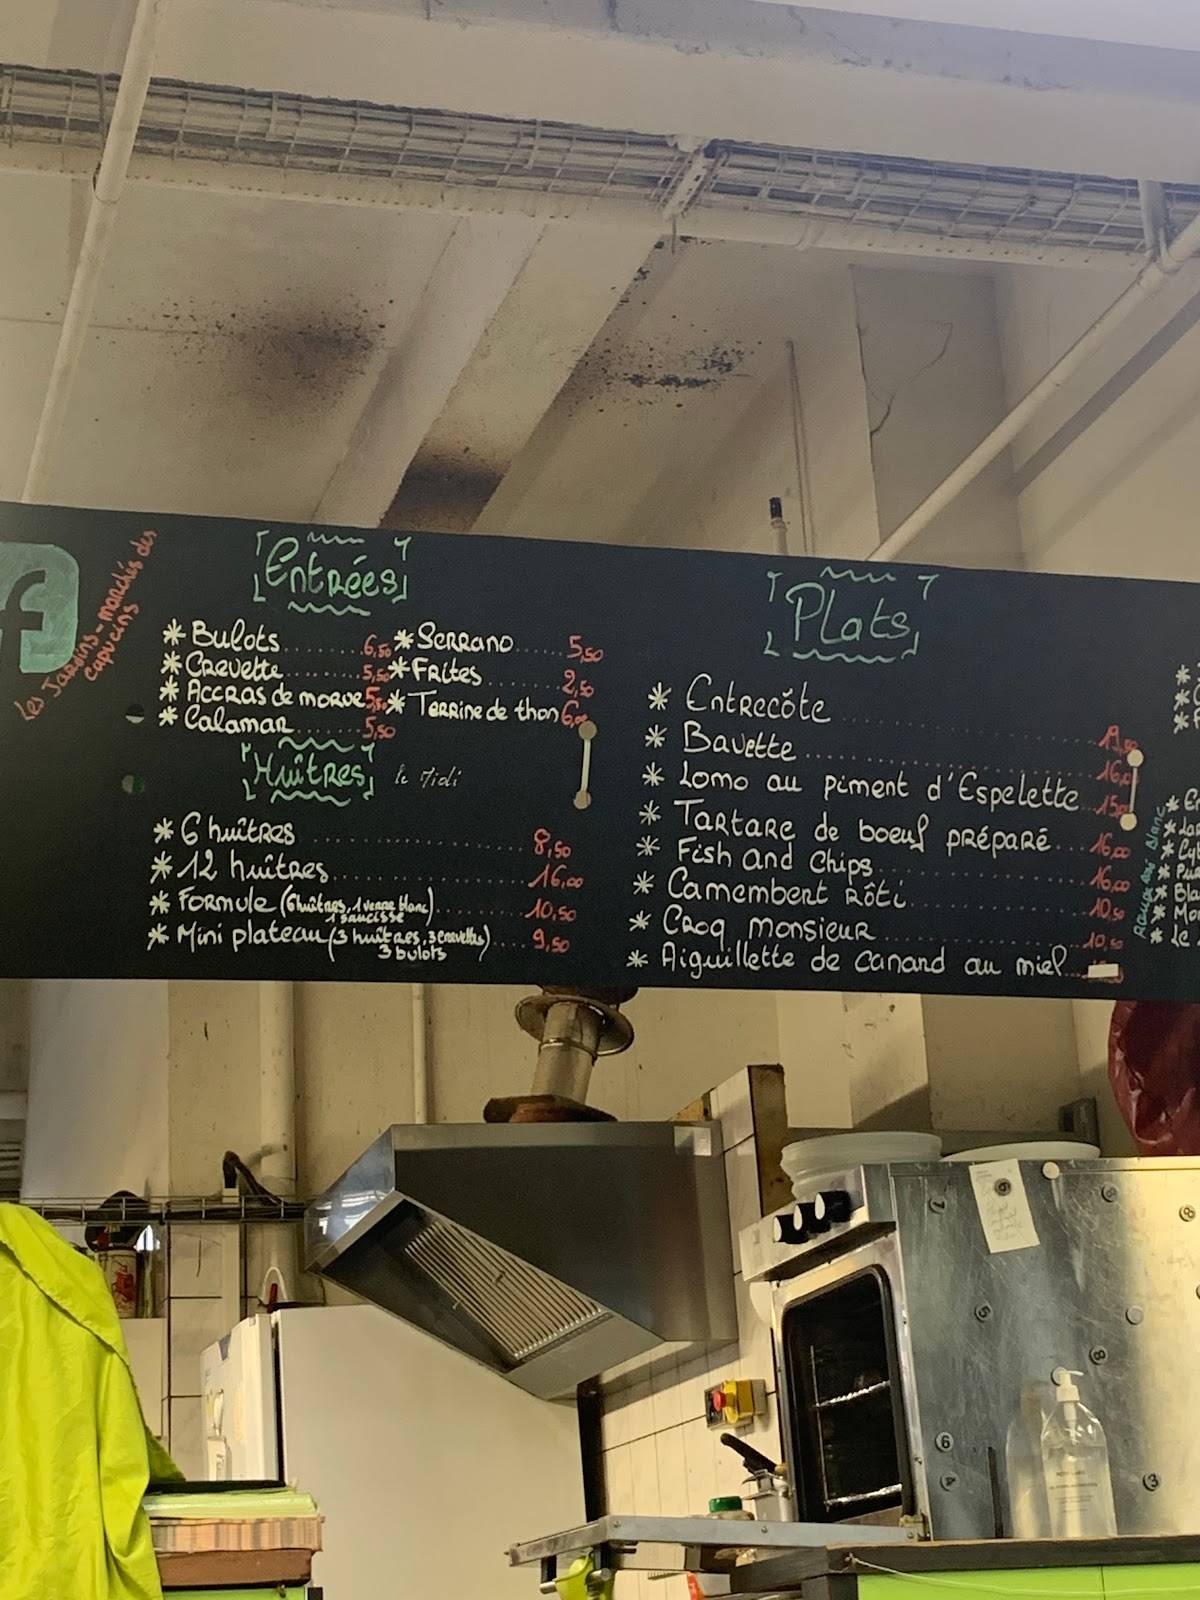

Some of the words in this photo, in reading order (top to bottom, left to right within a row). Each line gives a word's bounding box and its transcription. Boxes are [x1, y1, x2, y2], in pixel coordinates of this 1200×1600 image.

[265, 537, 399, 599] Entrées
[14, 696, 44, 720] Les
[41, 634, 100, 697] Jardins
[129, 530, 157, 557] des
[785, 582, 911, 645] Plats
[191, 618, 281, 652] Bulots
[362, 633, 393, 658] 6,50
[416, 621, 515, 653] Serrano
[566, 635, 604, 663] 5,50
[185, 650, 284, 682] Crevette
[361, 664, 391, 683] 5,50
[411, 656, 483, 687] Frites
[561, 668, 595, 698] 2,50
[187, 678, 267, 704] Accras
[271, 682, 294, 707] de
[407, 689, 483, 721] Terrine
[486, 697, 509, 722] de
[514, 696, 560, 723] thon
[686, 673, 832, 723] Entrecôte
[184, 703, 295, 735] Calamar
[362, 715, 396, 740] 5,50
[683, 720, 797, 762] Bavette
[253, 752, 366, 788] Huîtres
[679, 760, 749, 791] Lomo
[766, 773, 803, 792] au
[824, 770, 910, 801] piment
[926, 770, 1080, 812] d'Espelette
[180, 811, 201, 846] 6
[208, 815, 296, 846] huîtres
[533, 827, 572, 859] 8,50
[673, 798, 796, 841] Tartare
[814, 811, 840, 842] de
[859, 812, 930, 852] boeuf
[946, 825, 1051, 859] préparé
[1089, 832, 1132, 860] 16,00
[176, 848, 218, 882] 12
[230, 848, 329, 884] huîtres
[527, 864, 585, 890] 16,00
[677, 835, 732, 868] Fish
[1089, 864, 1131, 893] 16,00
[178, 885, 277, 914] Formule
[524, 898, 577, 922] 10,50
[667, 866, 829, 906] Camembert
[1089, 898, 1126, 922] 10,50
[178, 920, 223, 953] Mini
[232, 918, 328, 953] plateau
[532, 927, 570, 954] 9,50
[340, 911, 405, 924] saucisse
[662, 903, 726, 952] Croq
[378, 944, 392, 960] 3
[396, 945, 448, 962] bulots
[661, 940, 796, 979] Aiguillette
[810, 944, 841, 973] de
[964, 957, 1002, 975] au
[1015, 944, 1068, 976] miel
